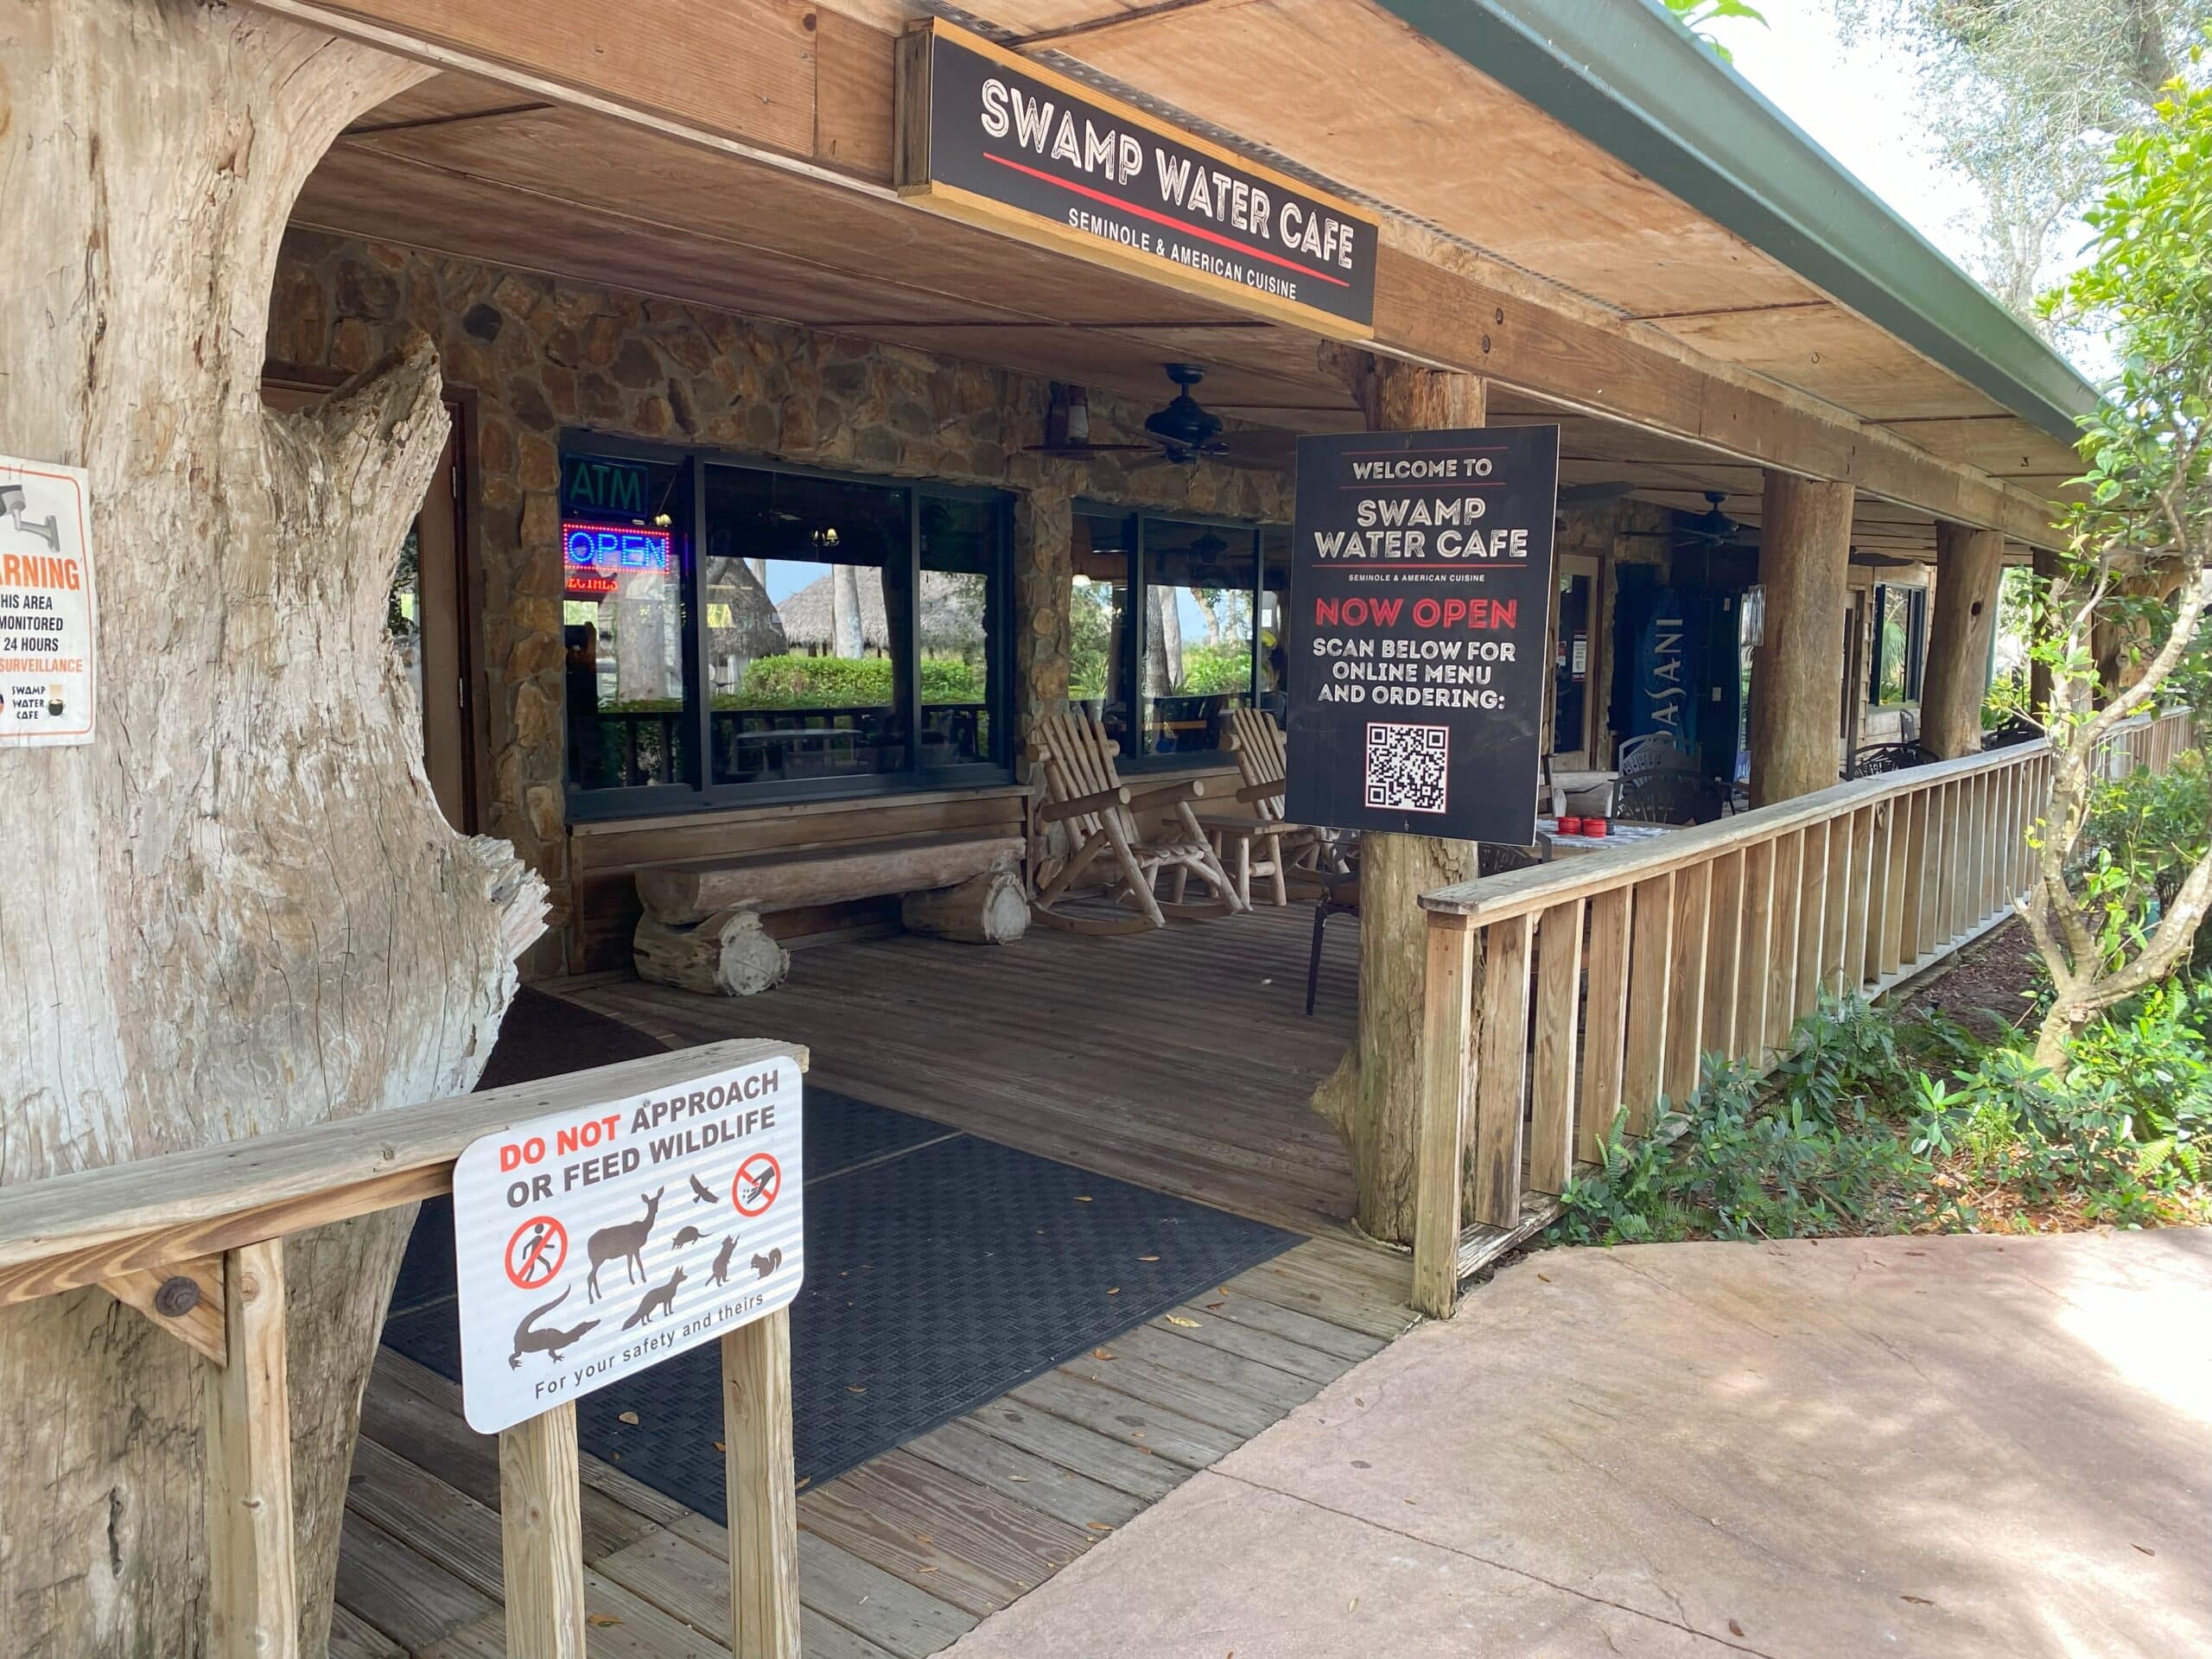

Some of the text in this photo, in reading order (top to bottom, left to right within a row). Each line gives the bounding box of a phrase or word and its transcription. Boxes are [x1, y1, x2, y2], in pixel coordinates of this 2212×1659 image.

[982, 79, 1354, 269] SWAMP WATER CAFE
[1069, 208, 1296, 300] SEMINOLE & AMERICAN CUISINE
[1353, 458, 1492, 480] WELCOME TO
[569, 462, 641, 512] ATM
[1357, 498, 1485, 527] SWAMP
[569, 531, 665, 567] OPEN
[1314, 529, 1528, 558] WATER CAFE
[1449, 574, 1485, 582] CUISINE
[22, 595, 53, 610] AREA
[1315, 597, 1516, 629] NOW OPEN
[0, 615, 63, 631] MONITORED
[3, 637, 59, 652] 24 HOURS
[1313, 639, 1516, 663] SCAN BELOW FOR
[0, 658, 83, 673] SURVEILLANCE
[1332, 662, 1491, 685] ONLINE MENU
[11, 685, 46, 695] SWAMP
[1318, 683, 1505, 709] AND ORDERING:
[12, 699, 45, 708] WATER
[499, 1070, 779, 1173] DO NOT APPROACH
[507, 1104, 775, 1208] OR FEED WILDLIFE
[535, 1293, 764, 1399] For your safety and theirs
